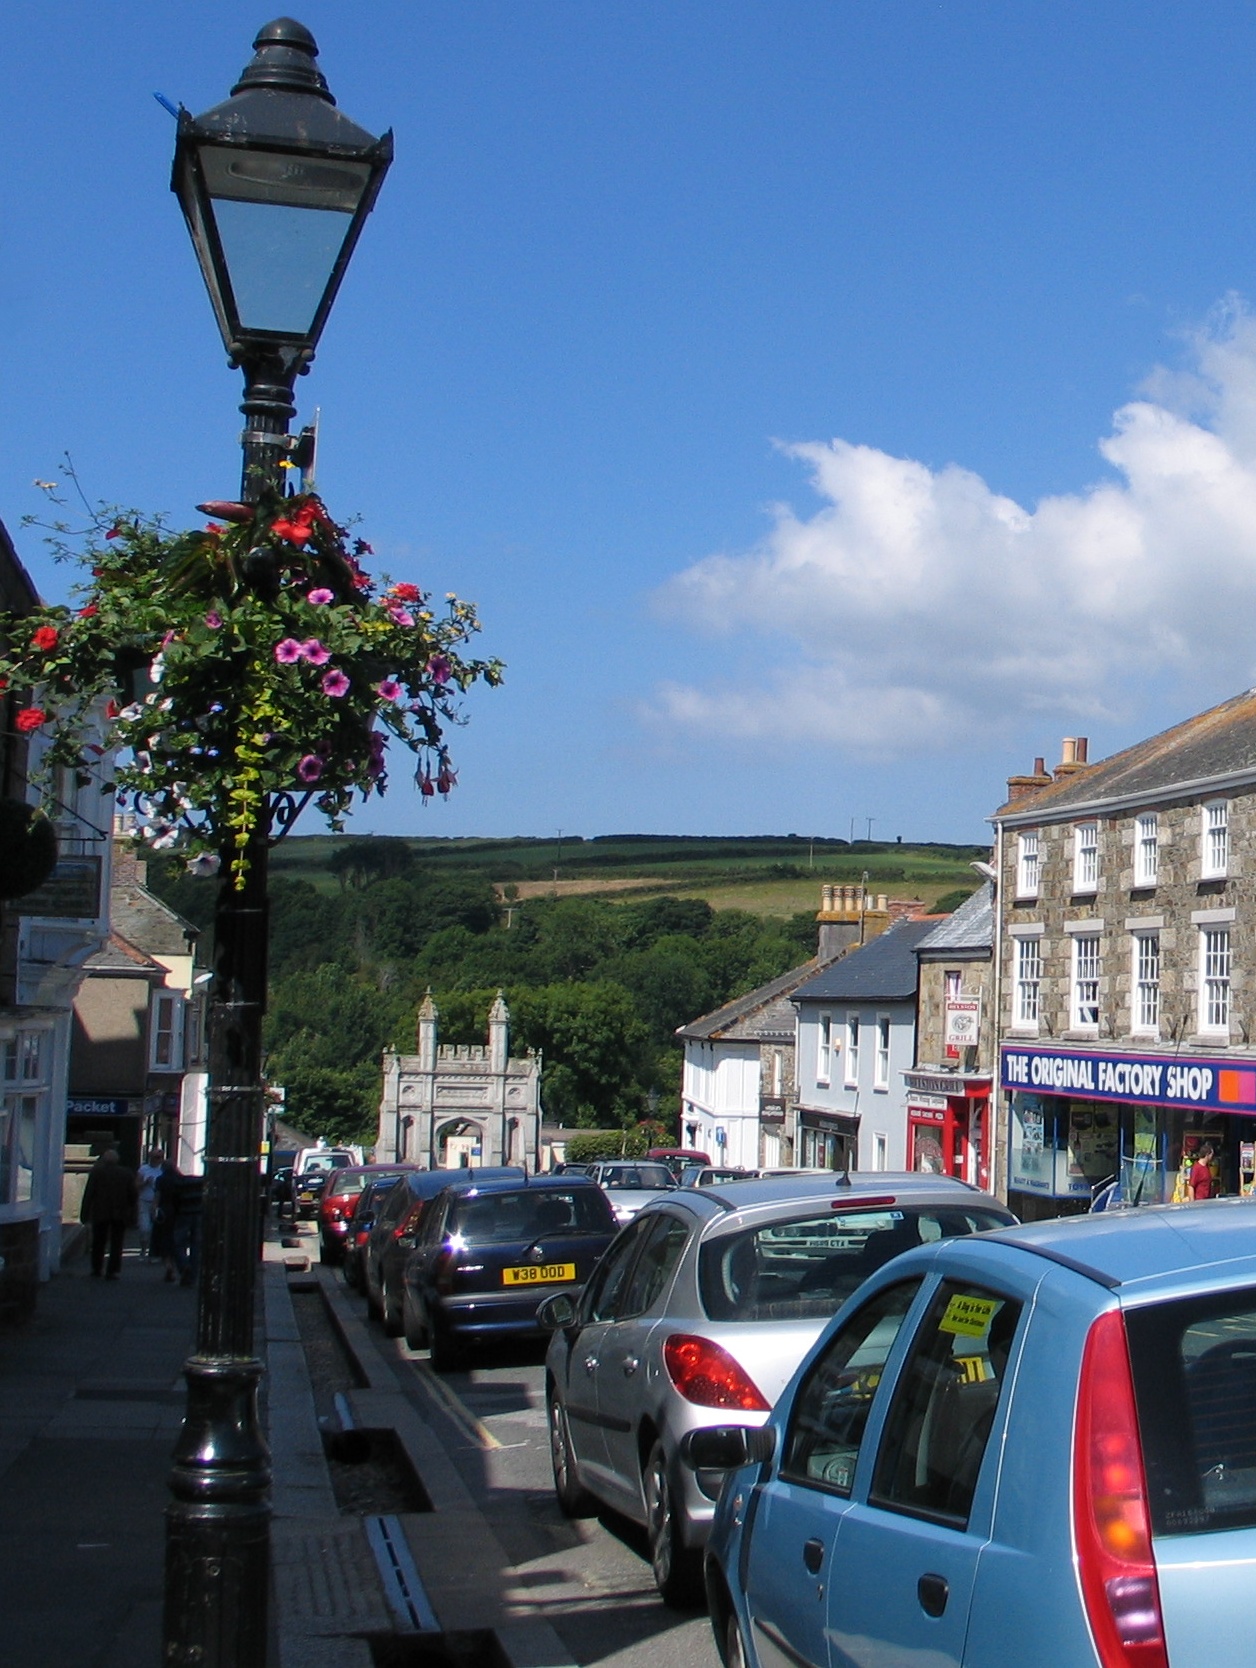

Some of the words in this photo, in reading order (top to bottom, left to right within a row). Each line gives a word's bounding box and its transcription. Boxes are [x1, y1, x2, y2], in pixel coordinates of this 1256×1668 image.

[948, 1034, 974, 1042] GRILL
[1006, 1054, 1028, 1083] THE
[1031, 1055, 1094, 1090] ORIGINAL
[1098, 1061, 1165, 1097] FACTORY
[1166, 1065, 1213, 1101] SHOP
[67, 1100, 116, 1113] Packet
